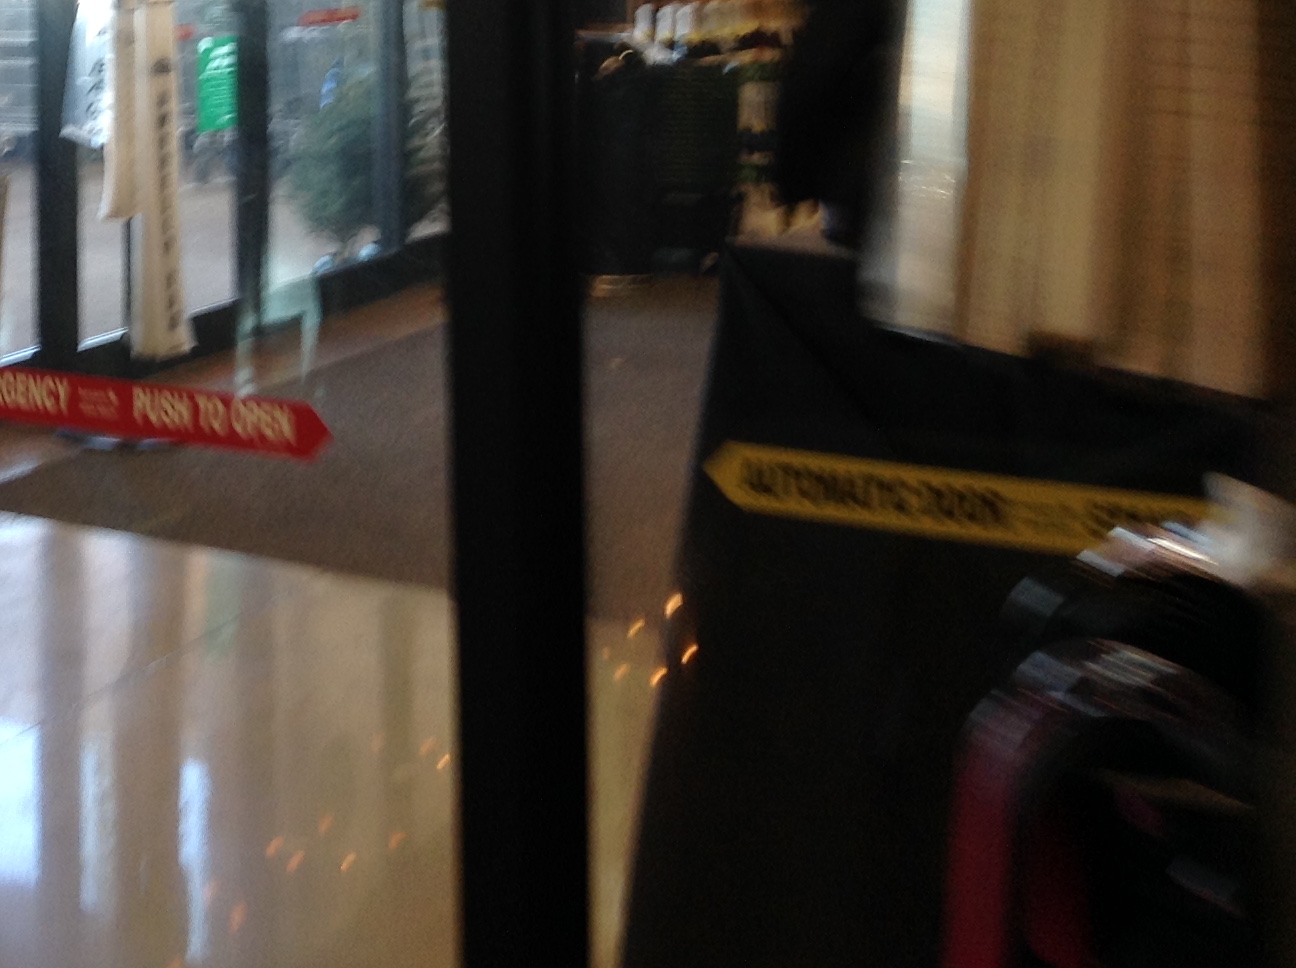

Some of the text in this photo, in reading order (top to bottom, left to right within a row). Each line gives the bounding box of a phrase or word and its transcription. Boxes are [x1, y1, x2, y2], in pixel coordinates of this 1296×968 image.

[132, 386, 193, 429] PUSH
[198, 393, 227, 435] TO
[230, 396, 297, 447] OPEN
